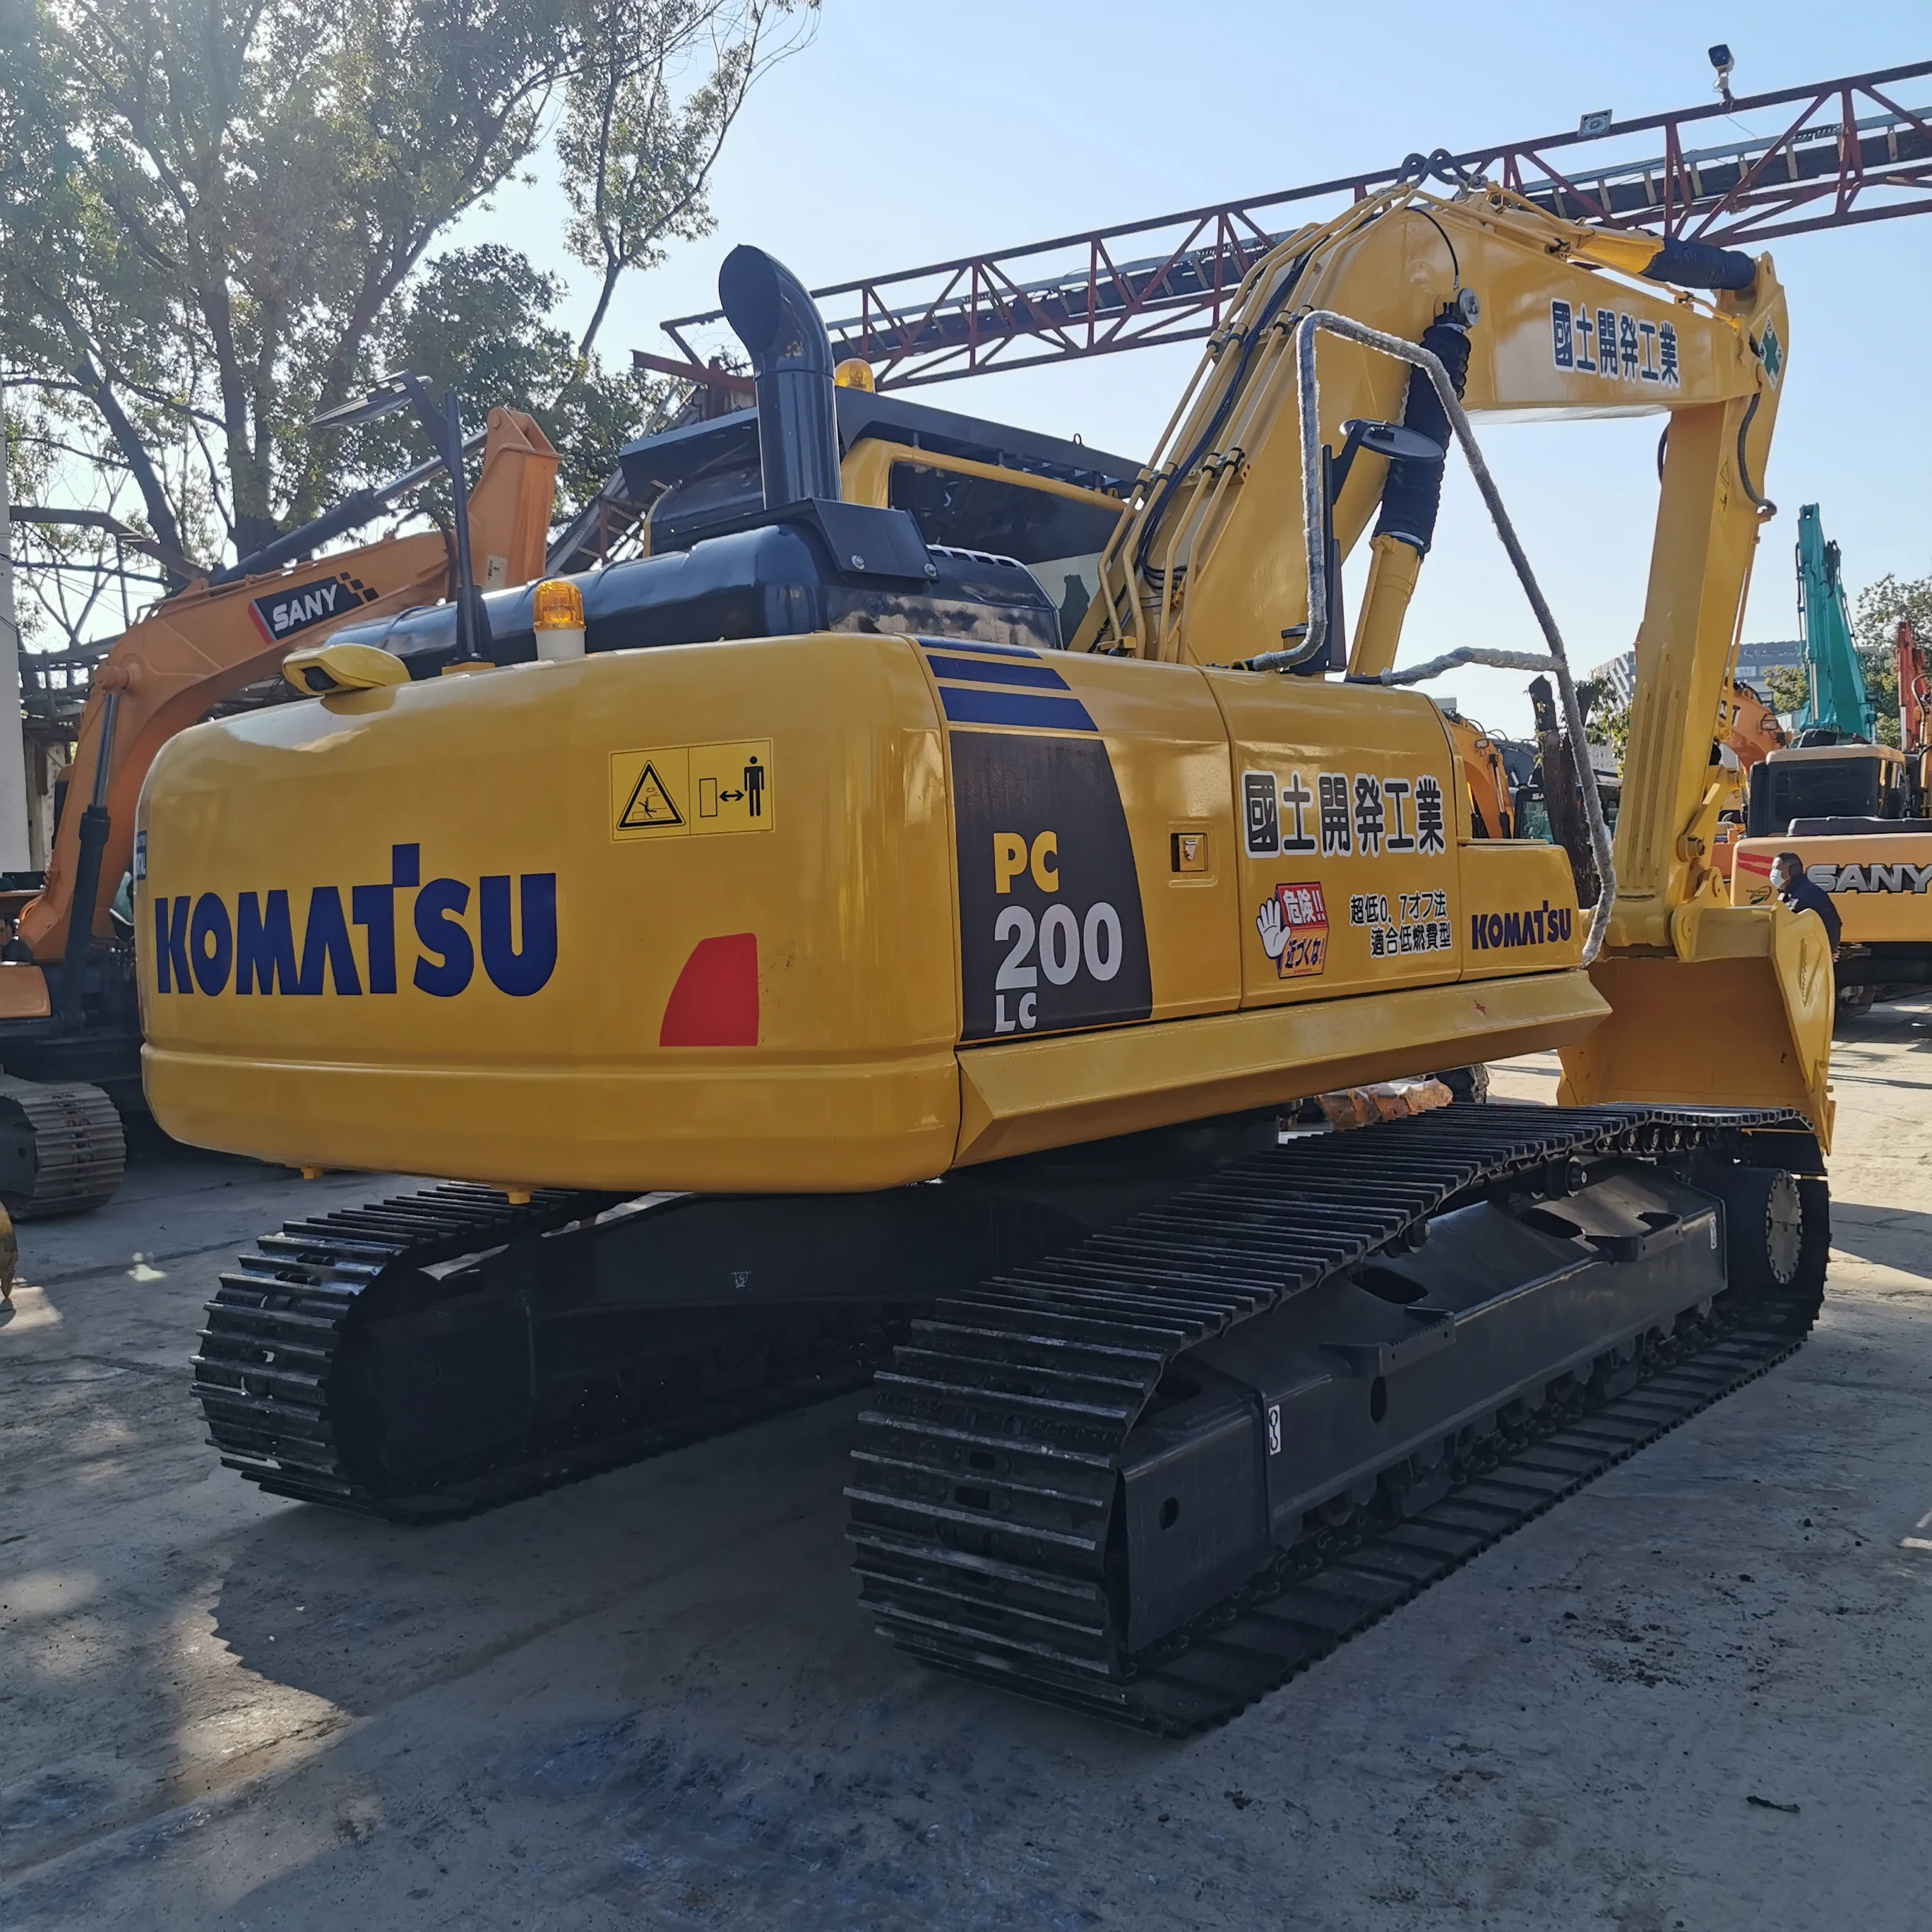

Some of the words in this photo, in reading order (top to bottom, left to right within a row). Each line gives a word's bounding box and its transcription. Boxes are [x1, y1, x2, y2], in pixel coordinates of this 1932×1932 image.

[273, 584, 338, 632] SANY
[1244, 773, 1445, 852] 國土開発工業
[993, 830, 1059, 893] PC
[1806, 863, 1932, 893] SANY
[155, 843, 557, 997] KOMATSU
[994, 902, 1123, 990] 200
[1472, 900, 1571, 950] KOMATSU
[994, 991, 1037, 1033] LC
